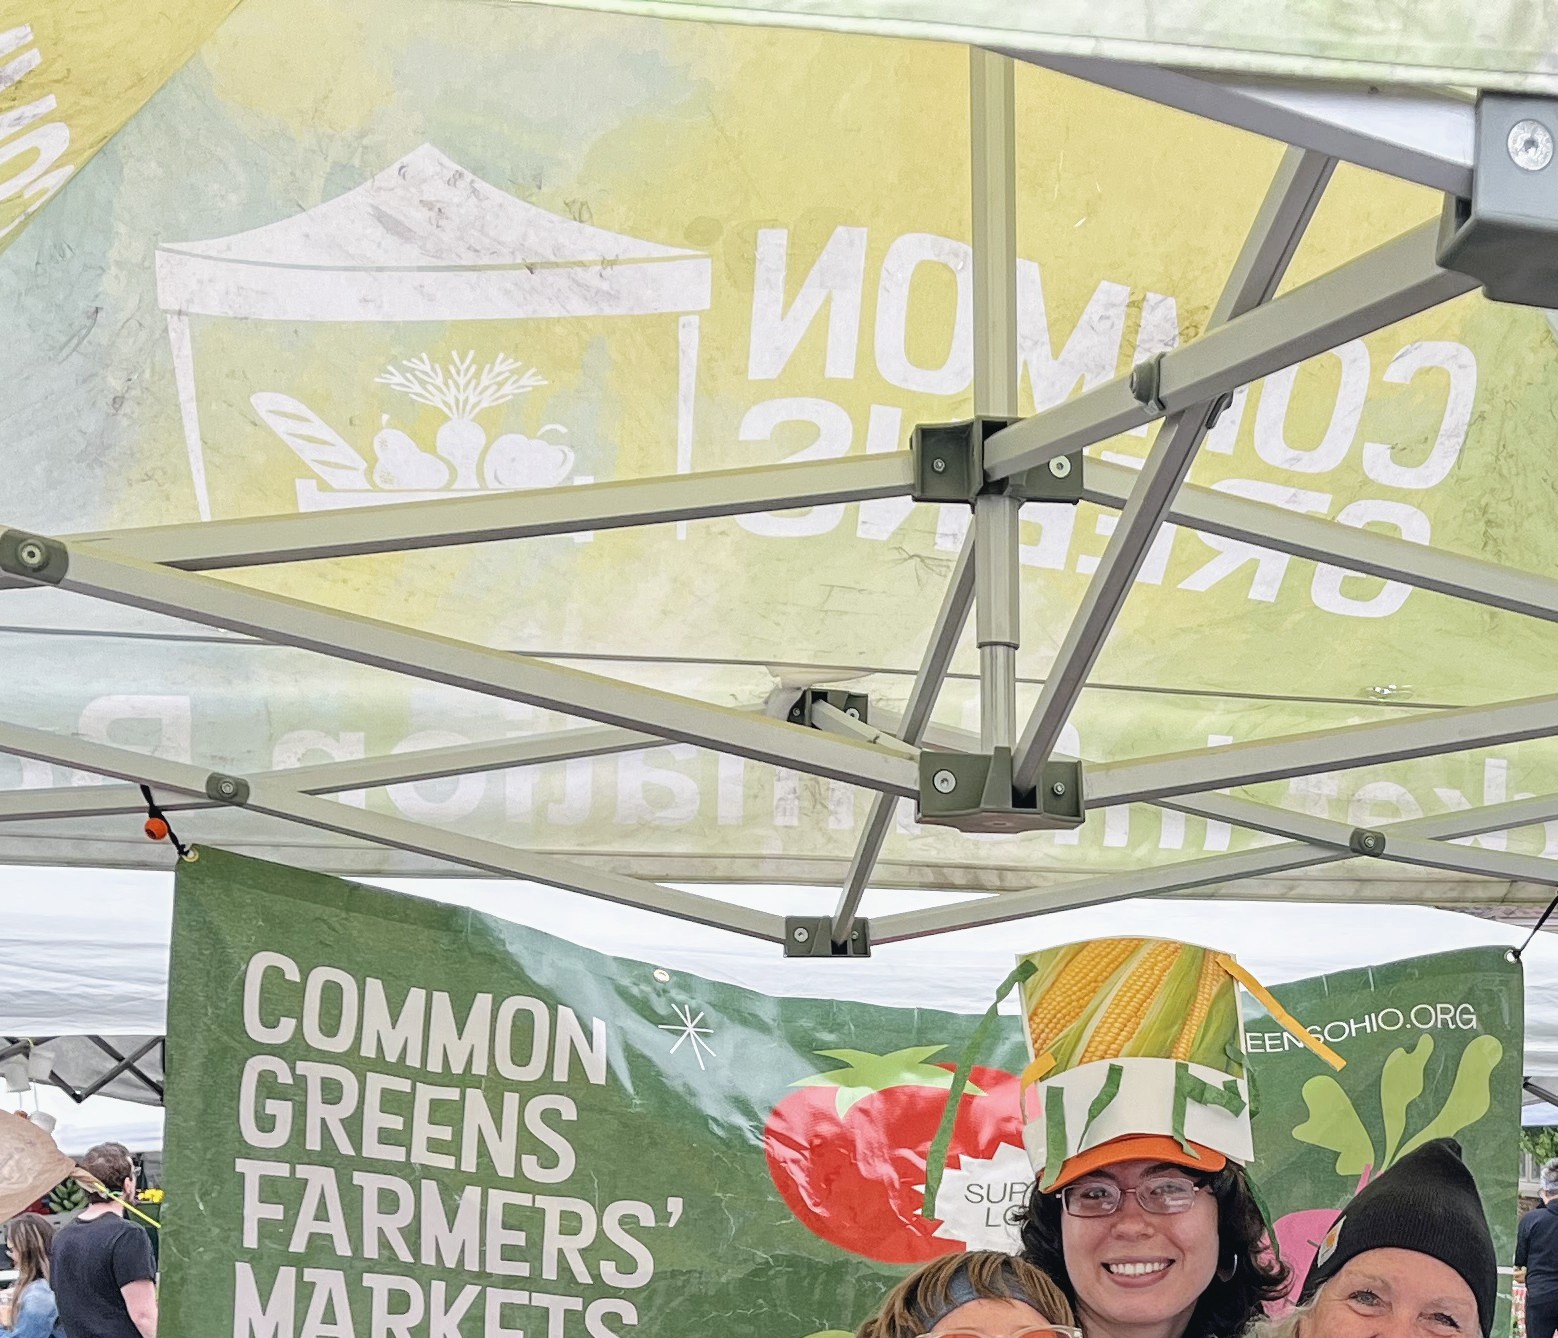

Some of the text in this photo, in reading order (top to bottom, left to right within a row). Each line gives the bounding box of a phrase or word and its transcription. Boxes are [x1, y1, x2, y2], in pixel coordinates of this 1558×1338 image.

[242, 951, 606, 1086] COMMON
[239, 1055, 577, 1183] GREENS
[234, 1161, 683, 1289] FARMERS'
